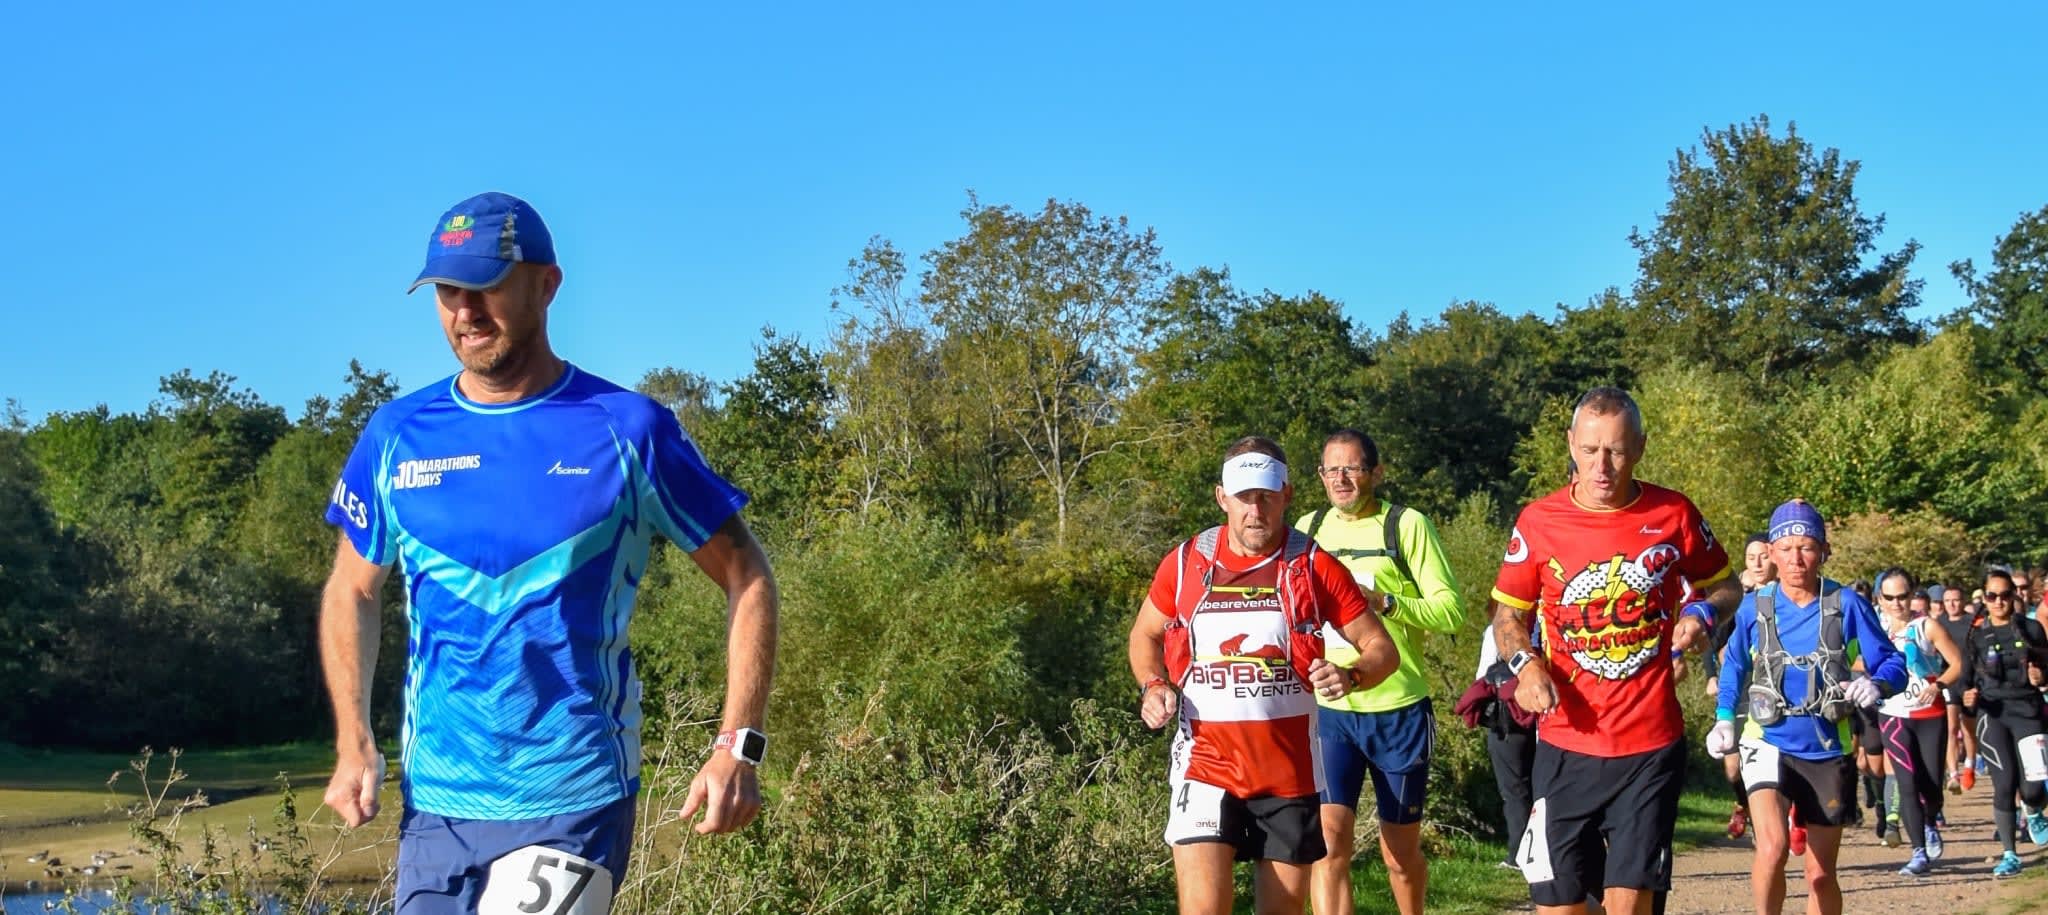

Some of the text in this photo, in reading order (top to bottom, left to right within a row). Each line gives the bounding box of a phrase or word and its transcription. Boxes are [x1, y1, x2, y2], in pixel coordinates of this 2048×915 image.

[417, 455, 481, 473] MARATHONS
[417, 473, 443, 488] DAYS
[1192, 664, 1227, 689] Big
[1234, 682, 1302, 698] EVENTS
[517, 854, 596, 915] 57
